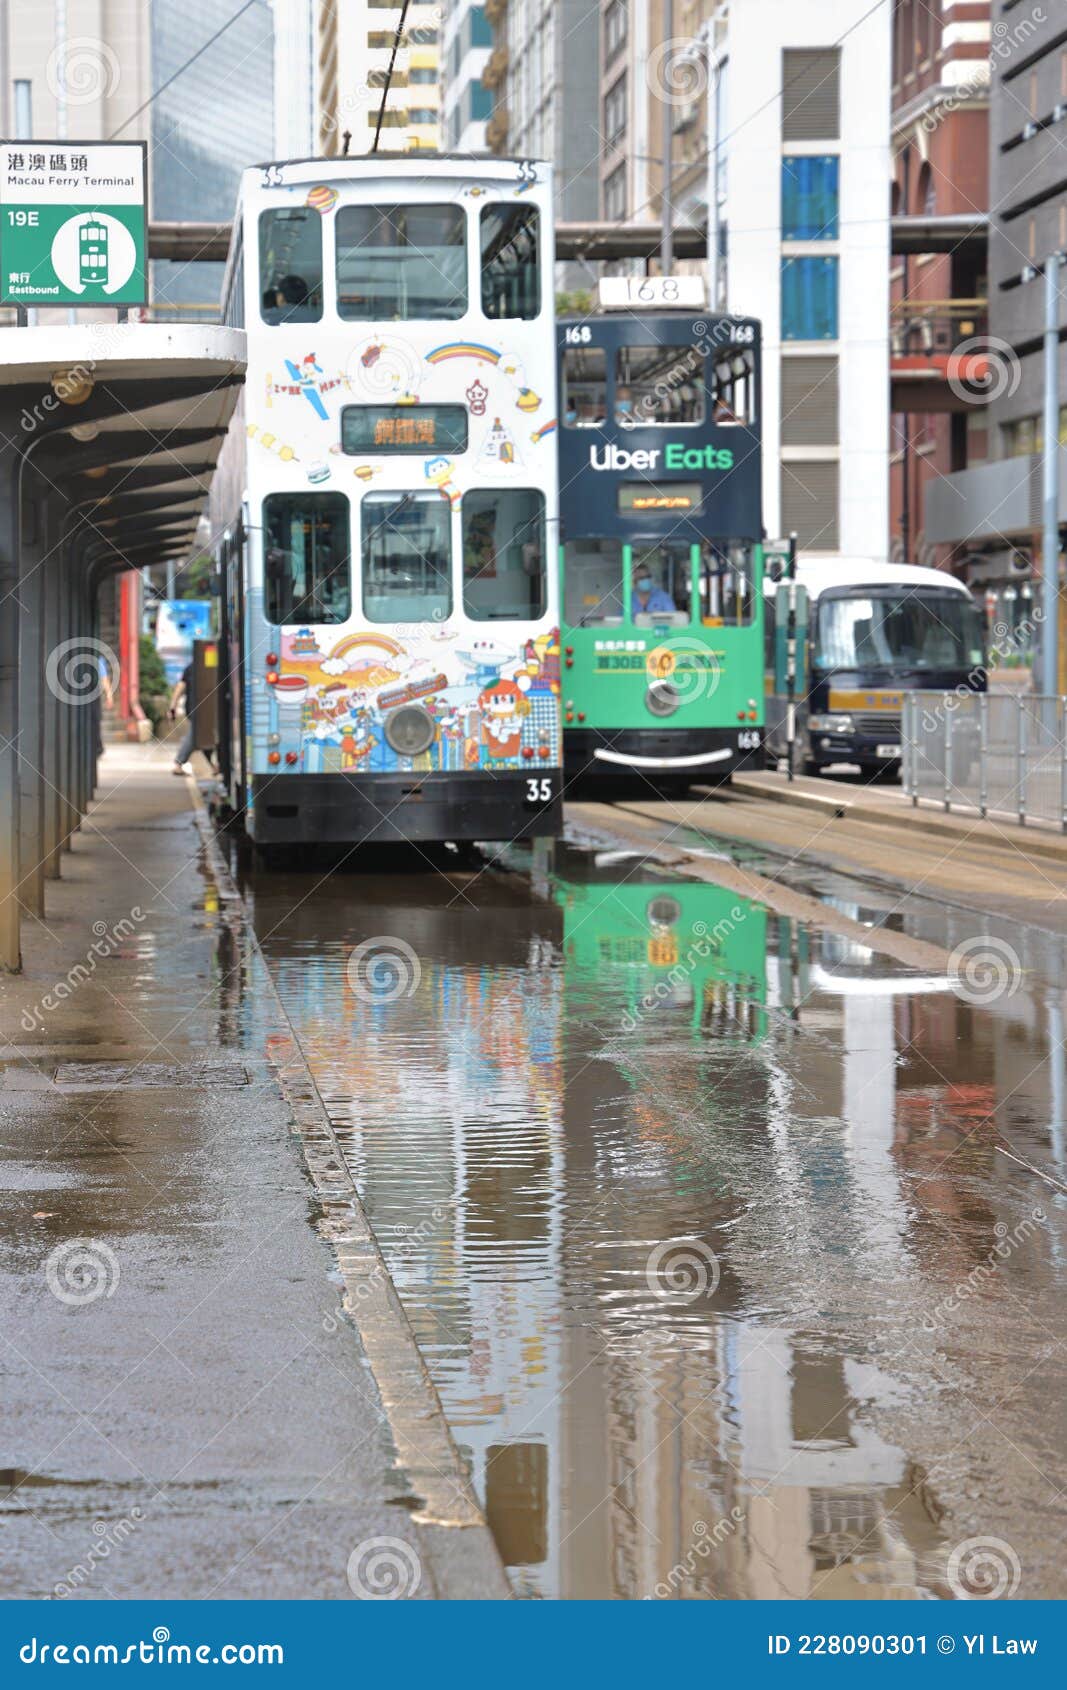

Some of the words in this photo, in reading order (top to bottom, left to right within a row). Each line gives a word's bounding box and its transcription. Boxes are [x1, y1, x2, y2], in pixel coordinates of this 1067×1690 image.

[7, 153, 88, 172] 港澳碼頭
[7, 176, 45, 186] Macau
[49, 176, 80, 187] Ferry
[83, 176, 135, 187] Terminal
[7, 211, 40, 227] 19E
[9, 272, 30, 284] 東行
[9, 286, 60, 295] Eastbound
[626, 279, 680, 301] 168
[565, 326, 592, 343] 168
[730, 326, 754, 343] 168
[590, 444, 661, 470] Uber
[665, 444, 734, 470] Eats
[738, 731, 760, 749] 168
[526, 778, 552, 802] 35
